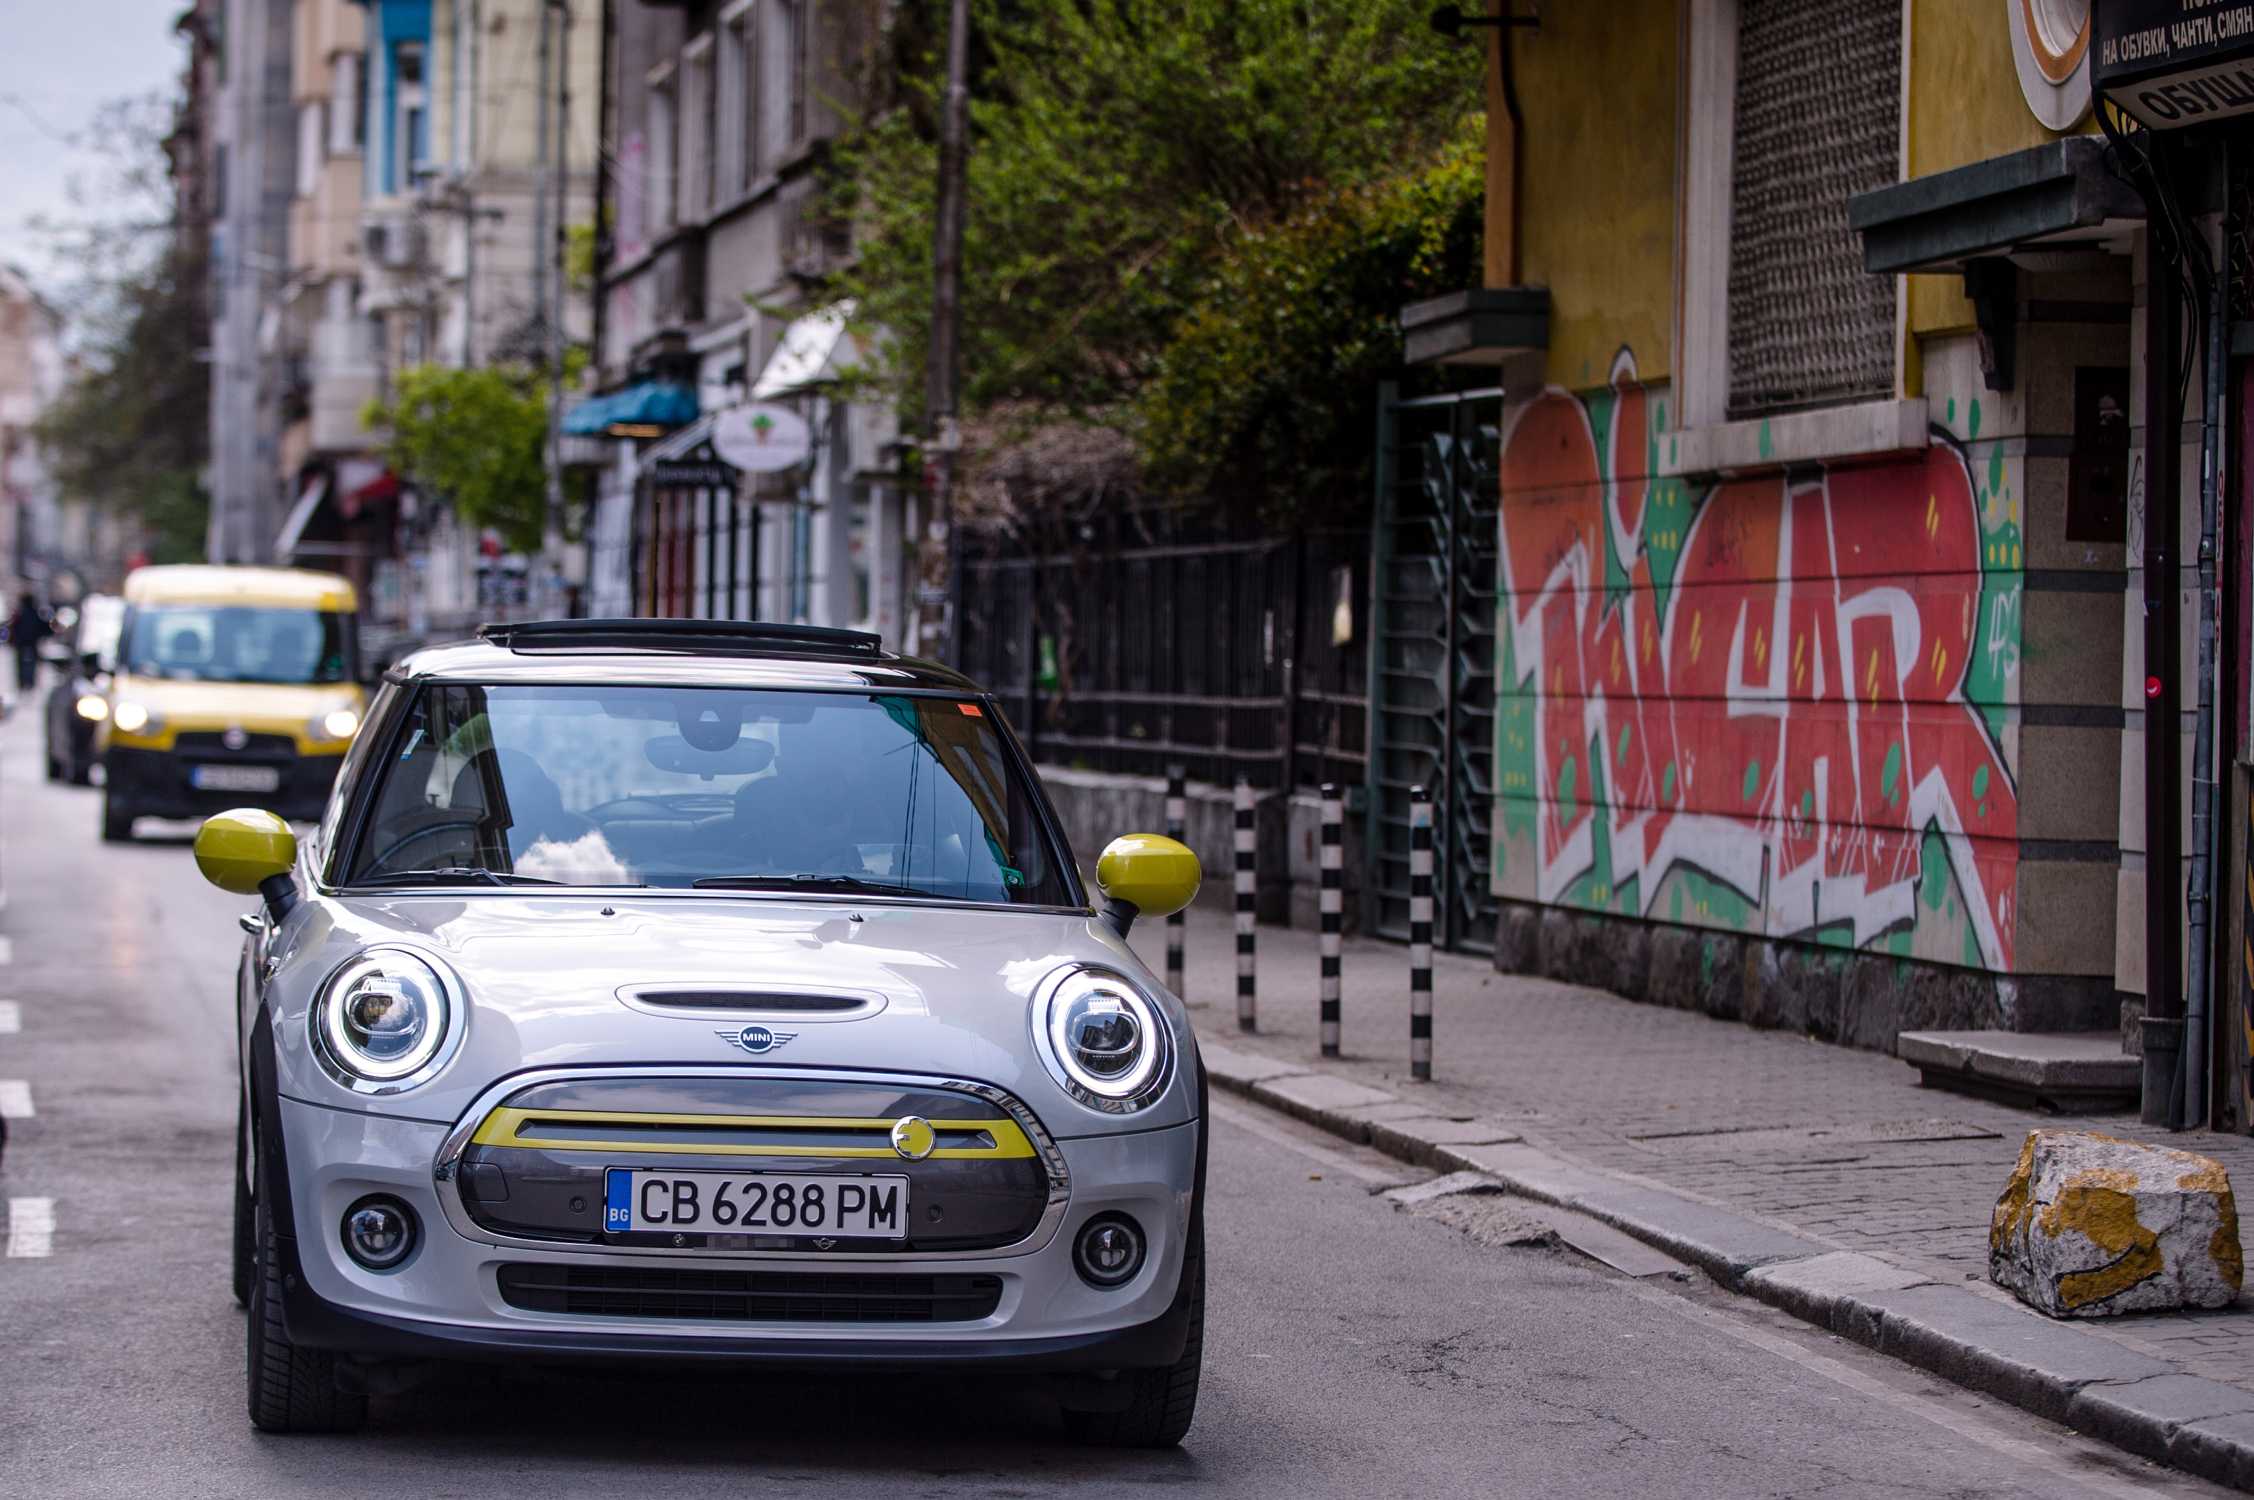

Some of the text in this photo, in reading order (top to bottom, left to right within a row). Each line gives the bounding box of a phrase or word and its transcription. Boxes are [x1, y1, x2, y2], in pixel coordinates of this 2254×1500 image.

[2102, 39, 2118, 66] НА
[2120, 27, 2171, 58] ОБУВКИ,
[2171, 17, 2218, 48] ЧАНТИ,
[742, 1032, 771, 1042] MINI
[609, 1208, 629, 1222] BG
[641, 1179, 898, 1230] CB 6288 PM
